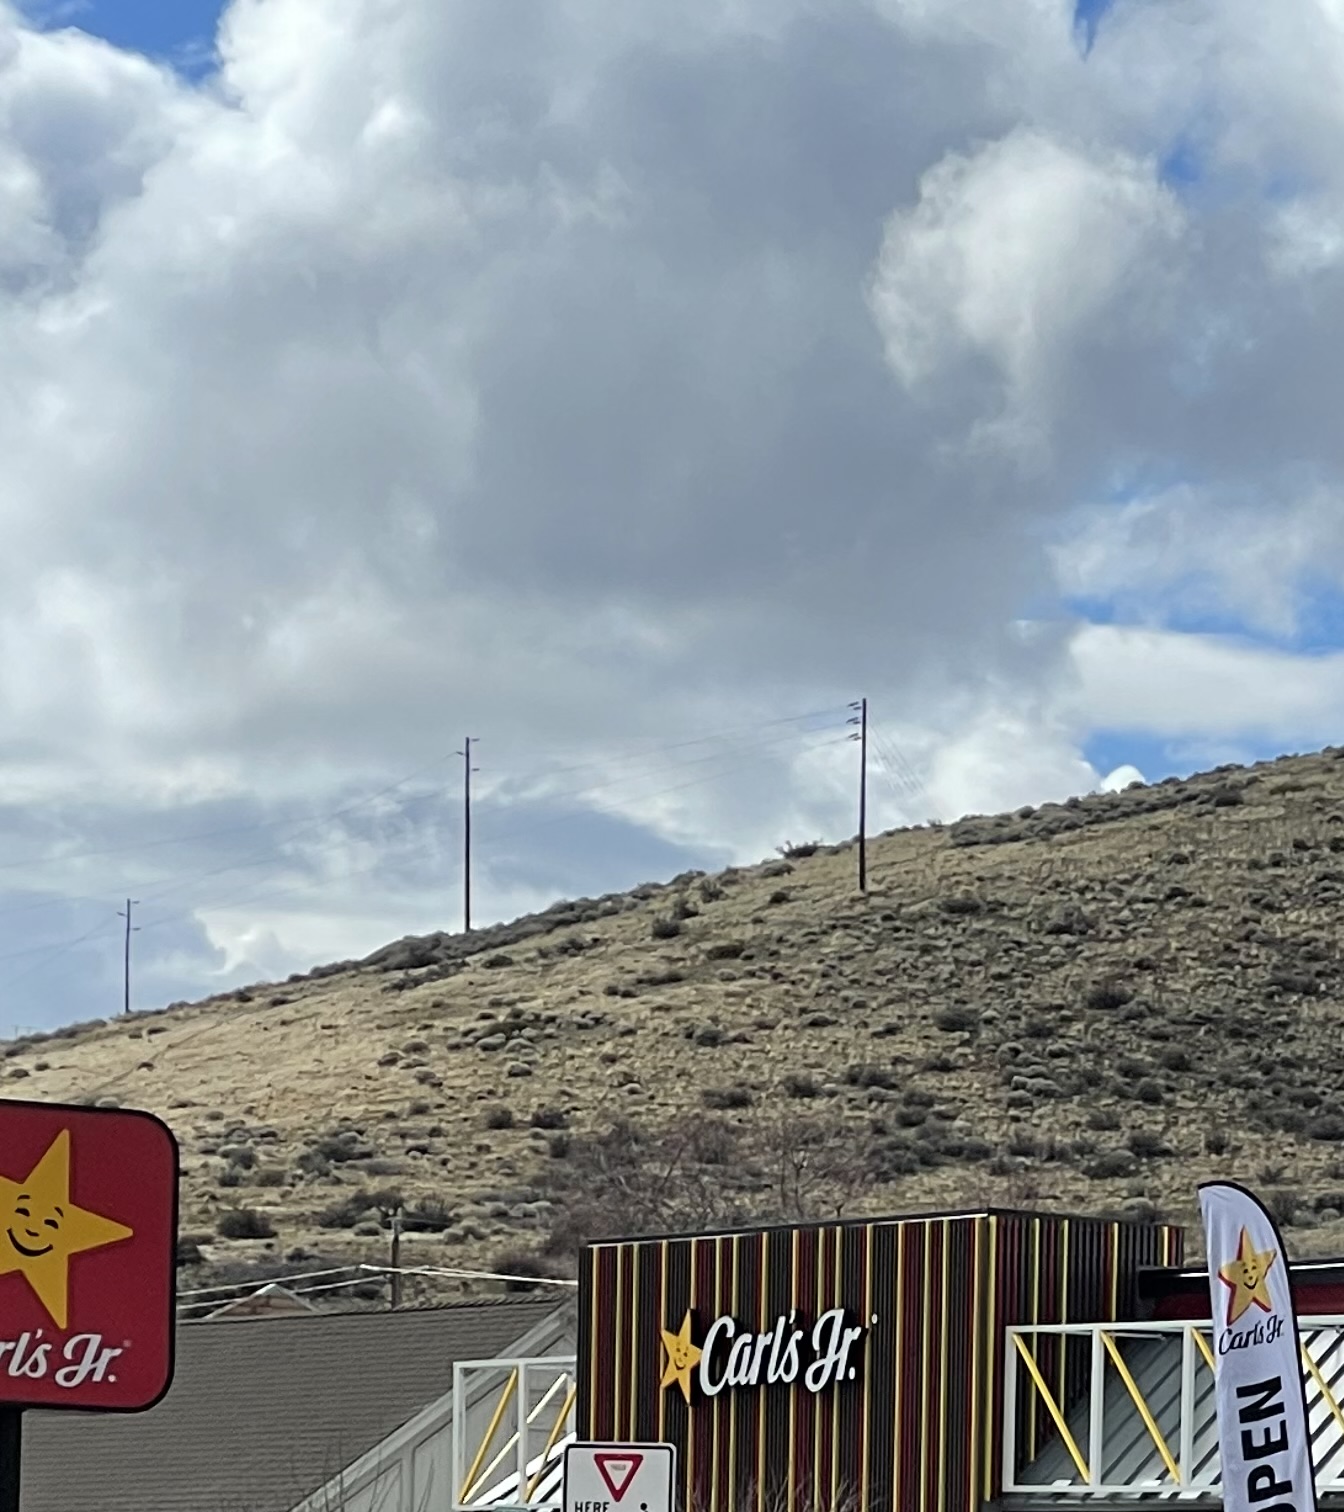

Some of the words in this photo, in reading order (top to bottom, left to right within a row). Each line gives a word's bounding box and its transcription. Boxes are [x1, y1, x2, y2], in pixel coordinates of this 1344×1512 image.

[0, 1327, 53, 1379] rl's
[55, 1332, 124, 1388] Jr.
[699, 1308, 804, 1396] Carl's
[805, 1308, 862, 1393] Jr.
[1218, 1319, 1265, 1356] Carl's
